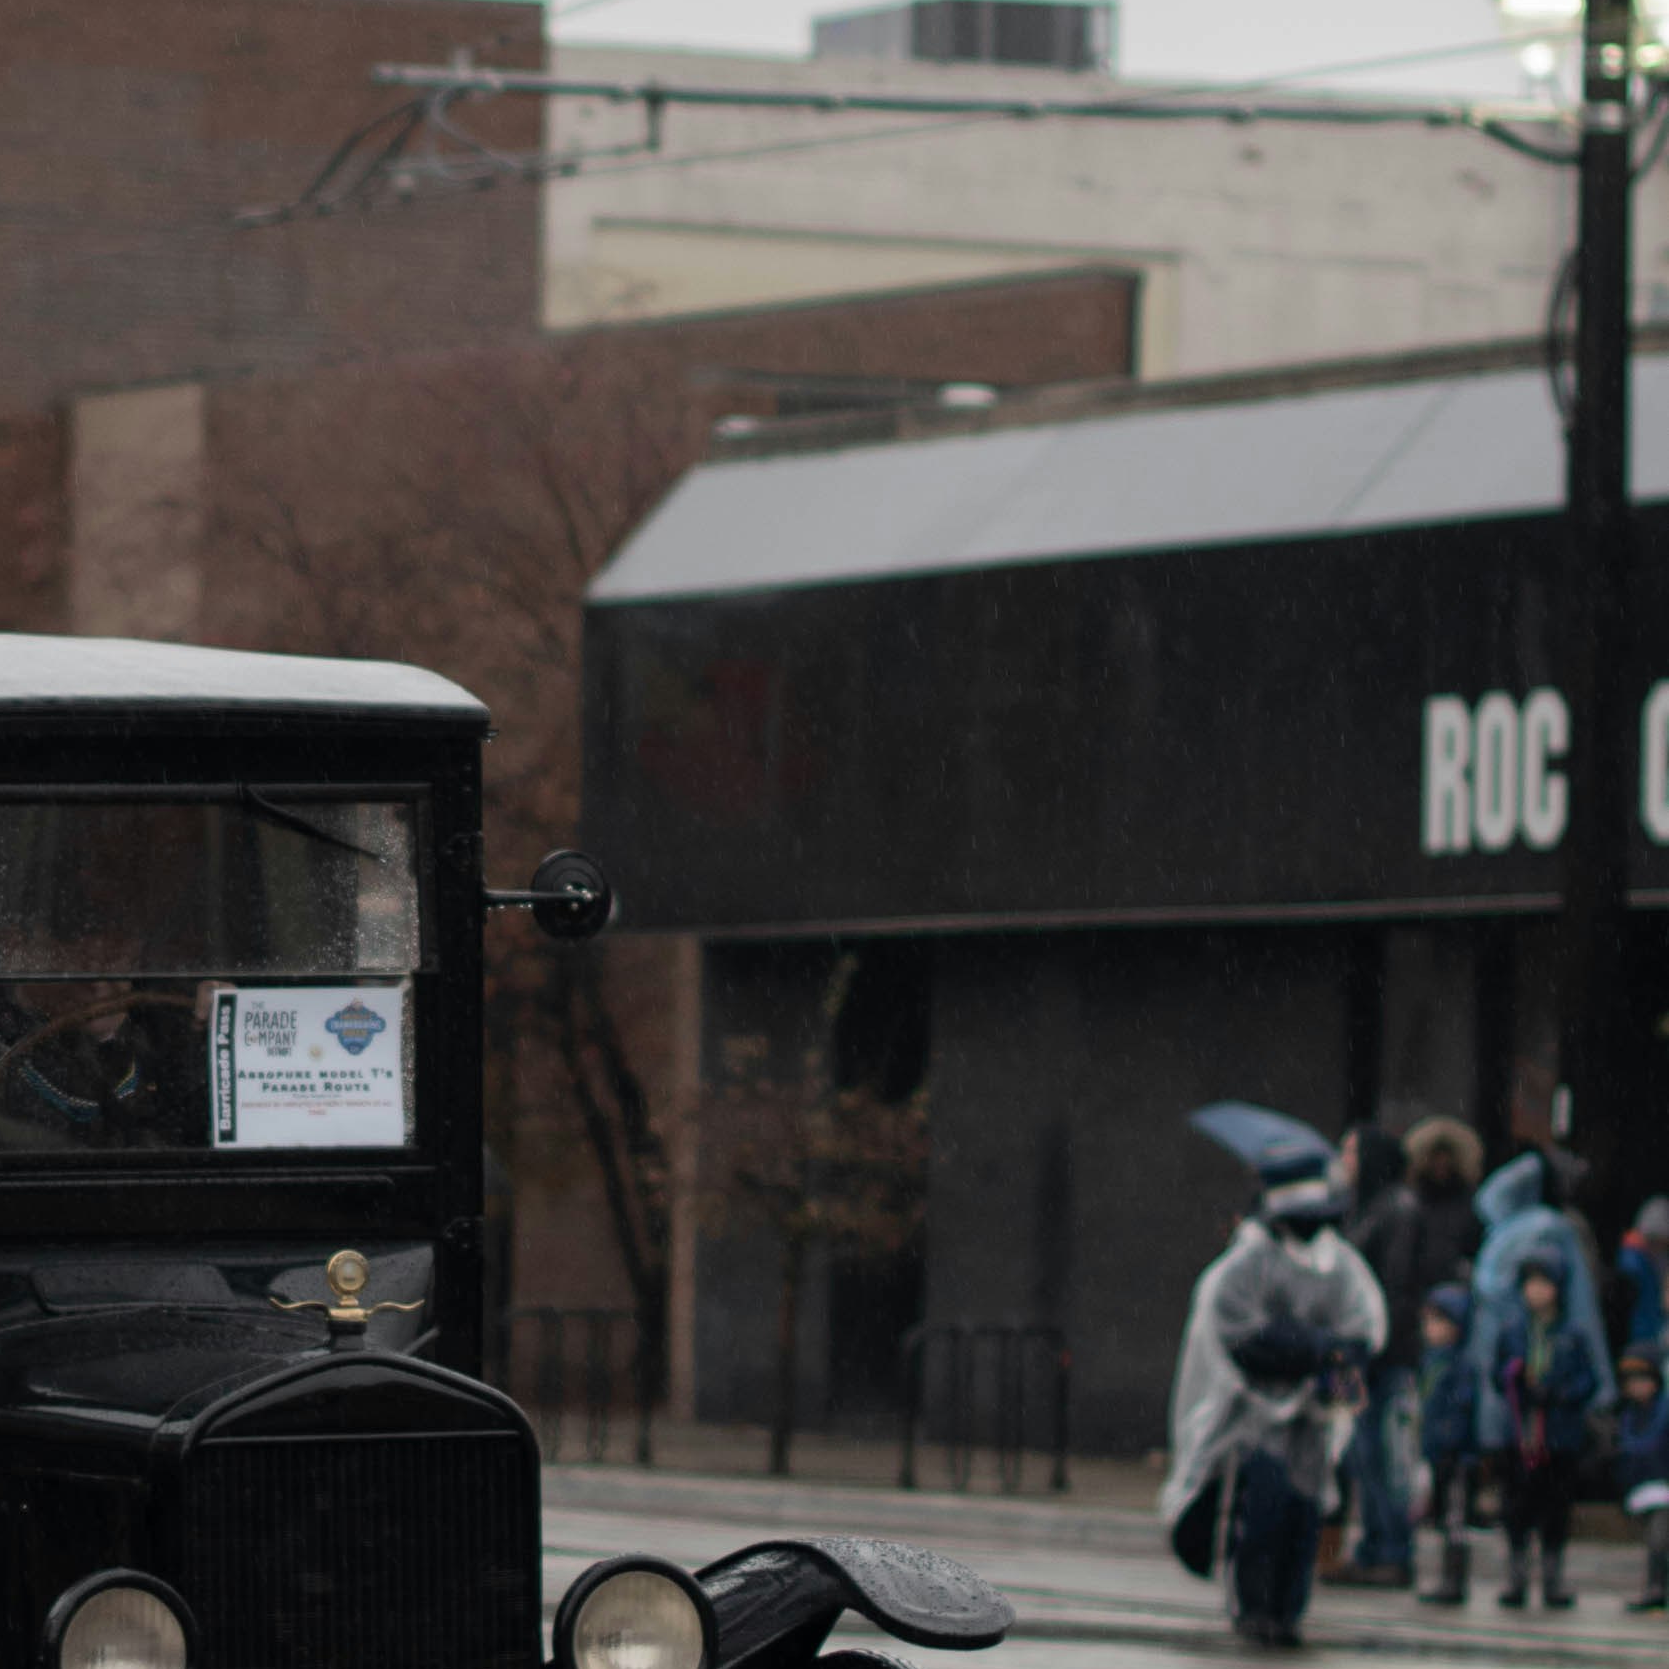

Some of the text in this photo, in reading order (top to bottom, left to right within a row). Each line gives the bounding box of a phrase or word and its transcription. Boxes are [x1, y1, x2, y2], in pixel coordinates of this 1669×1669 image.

[1421, 686, 1571, 856] ROC
[218, 1005, 230, 1044] Pass
[244, 1011, 297, 1029] PARADE
